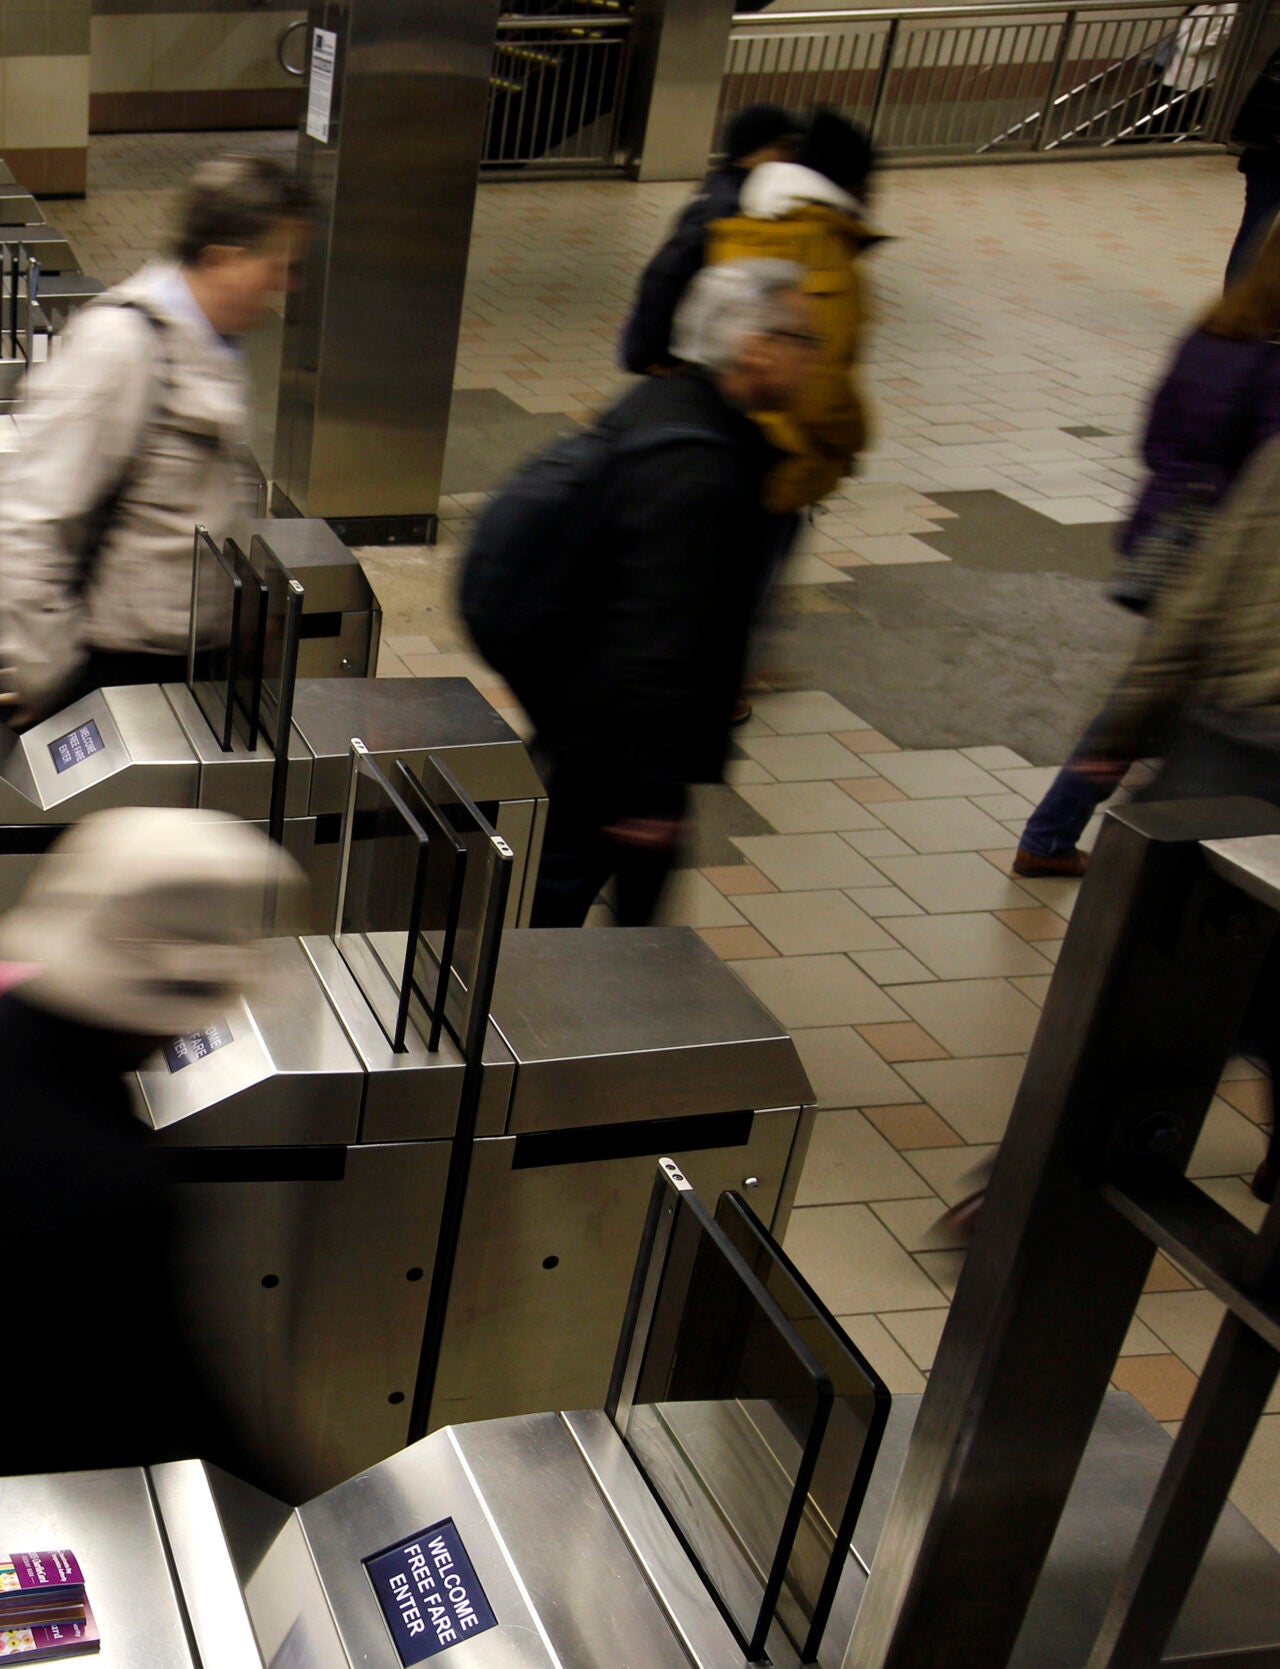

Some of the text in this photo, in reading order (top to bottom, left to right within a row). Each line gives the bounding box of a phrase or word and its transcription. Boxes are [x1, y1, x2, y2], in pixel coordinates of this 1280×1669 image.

[58, 743, 72, 765] ENTER
[68, 732, 86, 762] FREE FARE
[80, 726, 97, 755] WELCOME
[190, 1032, 207, 1060] FARE
[403, 1543, 457, 1646] FREE FARE
[427, 1535, 479, 1631] WELCOME
[388, 1572, 425, 1638] ENTER
